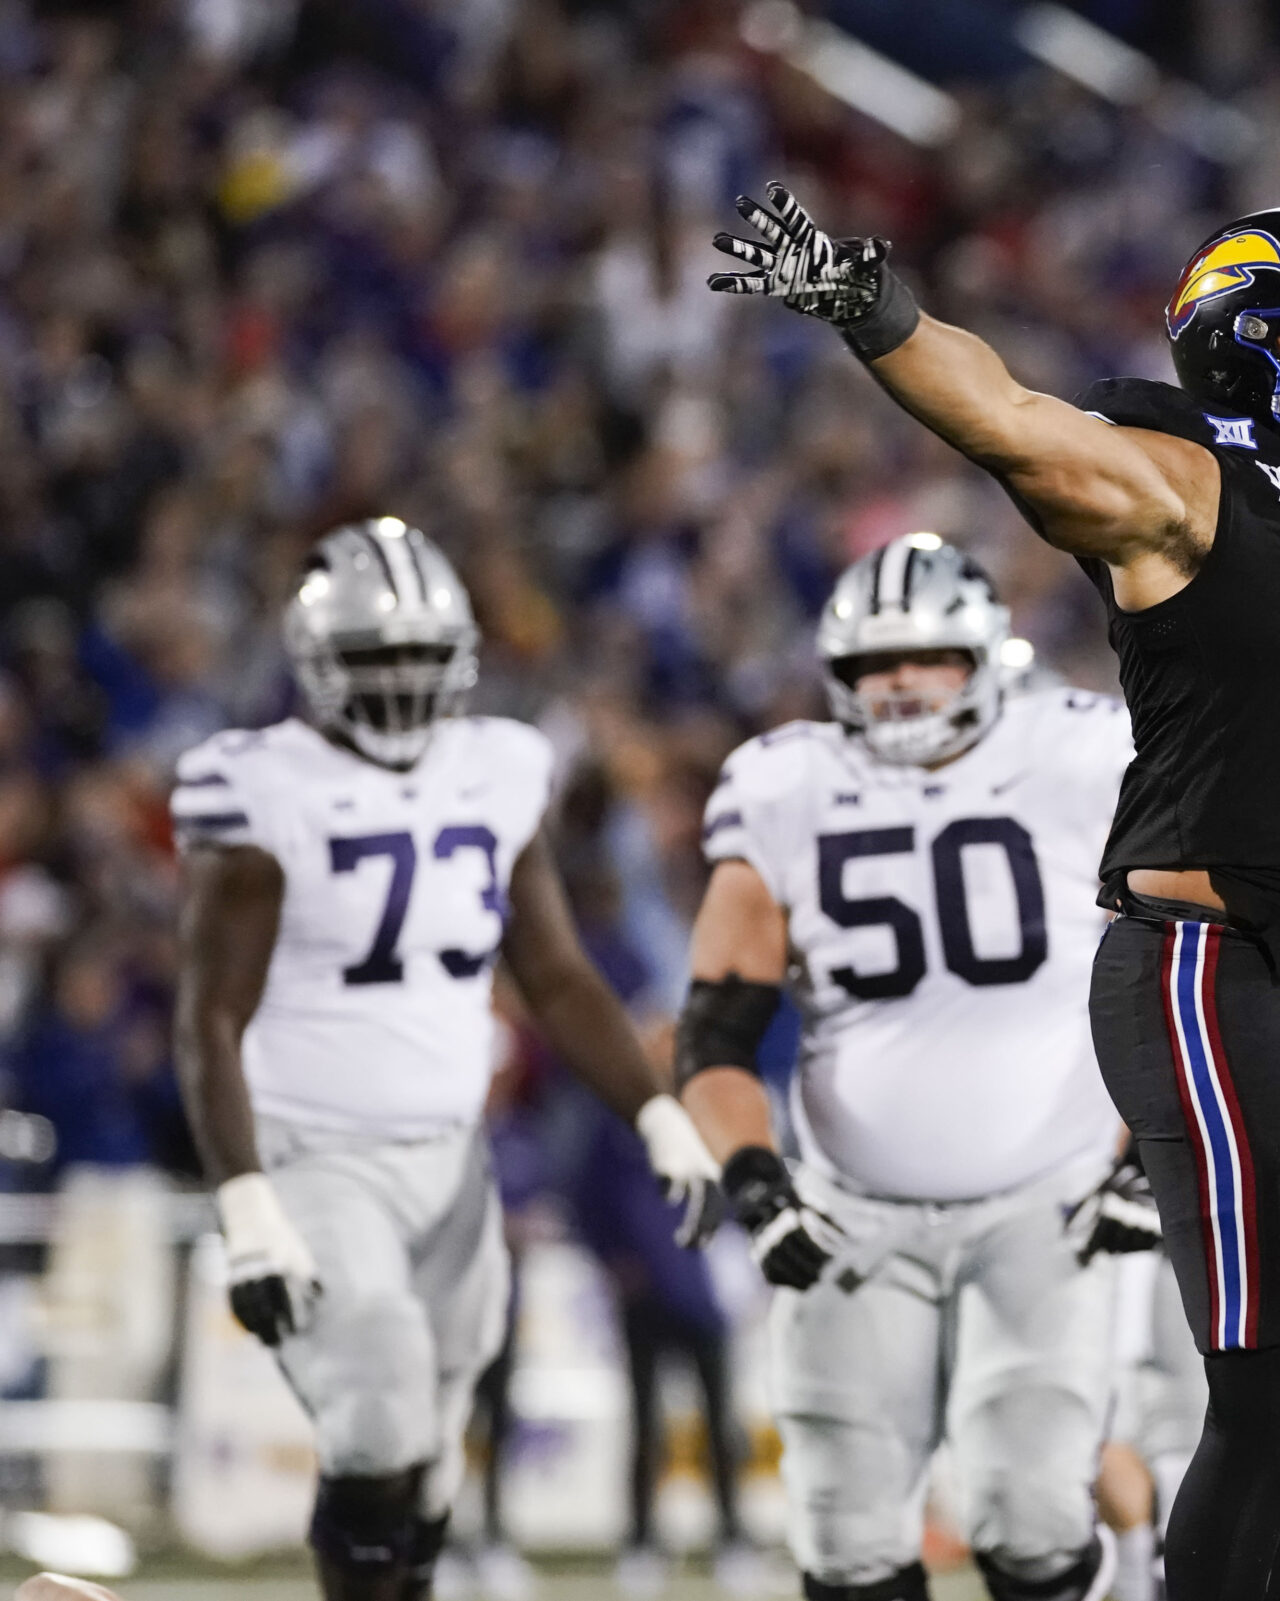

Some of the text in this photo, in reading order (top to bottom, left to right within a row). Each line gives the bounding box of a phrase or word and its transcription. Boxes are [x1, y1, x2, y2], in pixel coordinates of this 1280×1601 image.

[1203, 413, 1257, 449] XII
[329, 825, 509, 987] 73
[817, 816, 1049, 1000] 50
